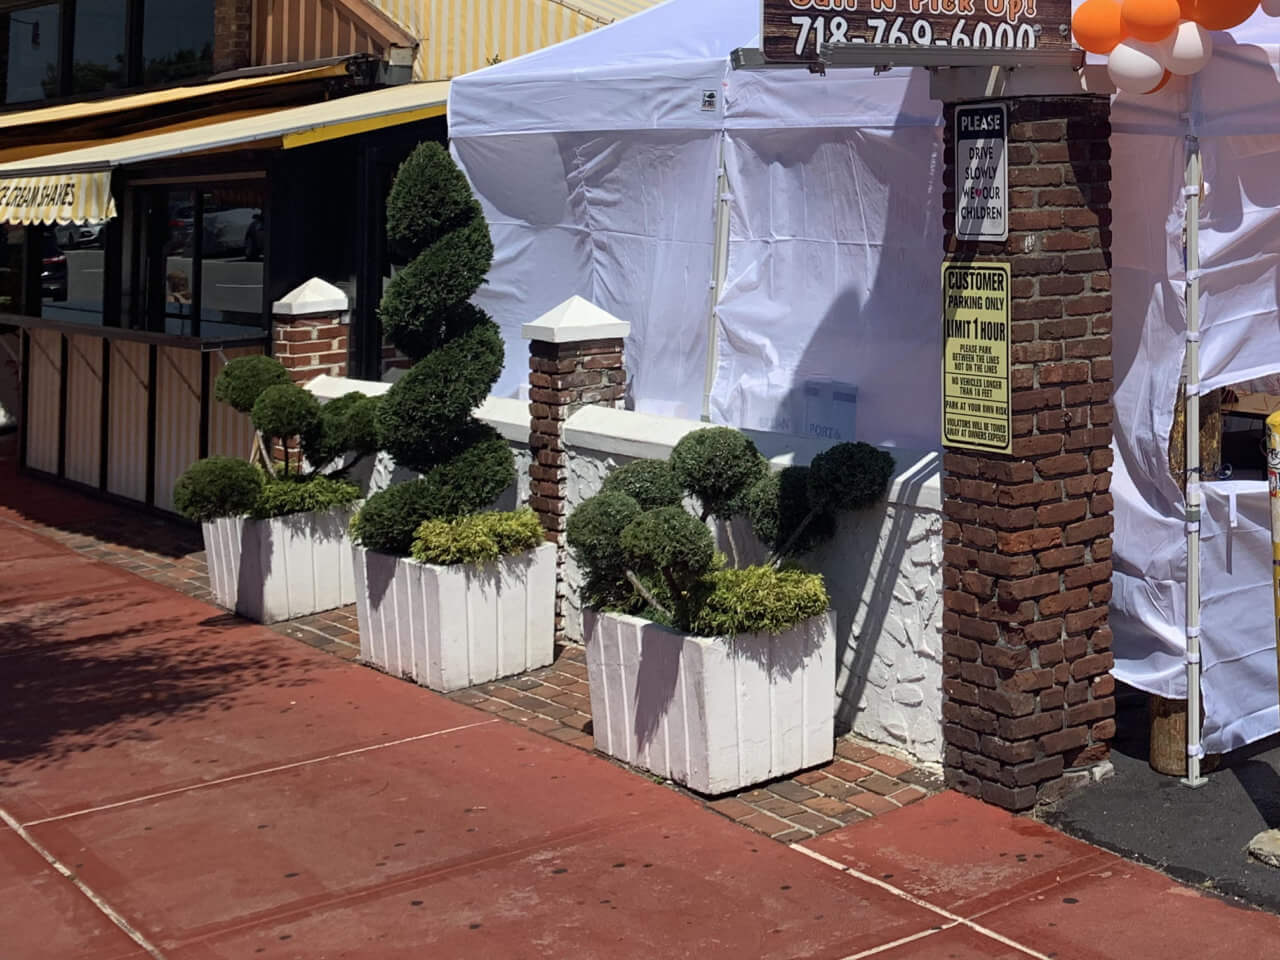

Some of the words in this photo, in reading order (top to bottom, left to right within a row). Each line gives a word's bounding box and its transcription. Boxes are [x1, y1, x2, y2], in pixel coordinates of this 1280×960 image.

[791, 16, 1036, 56] 718-769-6000
[961, 115, 1000, 131] PLEASE
[969, 147, 993, 160] DRIVE
[965, 167, 997, 180] SLOWLY
[963, 188, 975, 199] WE
[982, 187, 1000, 200] OUR
[961, 207, 1002, 220] CHILDREN
[949, 271, 1004, 291] CUSTOMER
[949, 295, 983, 310] PARKING
[985, 296, 1004, 311] ONLY
[947, 319, 971, 340] LIMIT
[973, 317, 979, 340] 1
[980, 320, 1005, 342] HOUR
[960, 344, 977, 353] PLEASE
[979, 345, 992, 354] PARK
[952, 352, 975, 362] BETWEEN
[976, 355, 985, 363] THE
[986, 356, 999, 365] LINES
[954, 362, 964, 371] NOT
[975, 364, 983, 373] THE
[984, 365, 997, 374] LINES
[960, 377, 982, 387] VEHICLES
[984, 379, 1002, 389] LONGER
[960, 387, 973, 396] THAN
[982, 389, 992, 398] FEET
[945, 400, 959, 409] PARK
[960, 402, 966, 411] AT
[968, 403, 981, 412] YOUR
[995, 406, 1008, 415] RISK
[947, 418, 971, 429] VIOLATORS
[972, 421, 982, 430] WILL
[961, 429, 967, 438] AT
